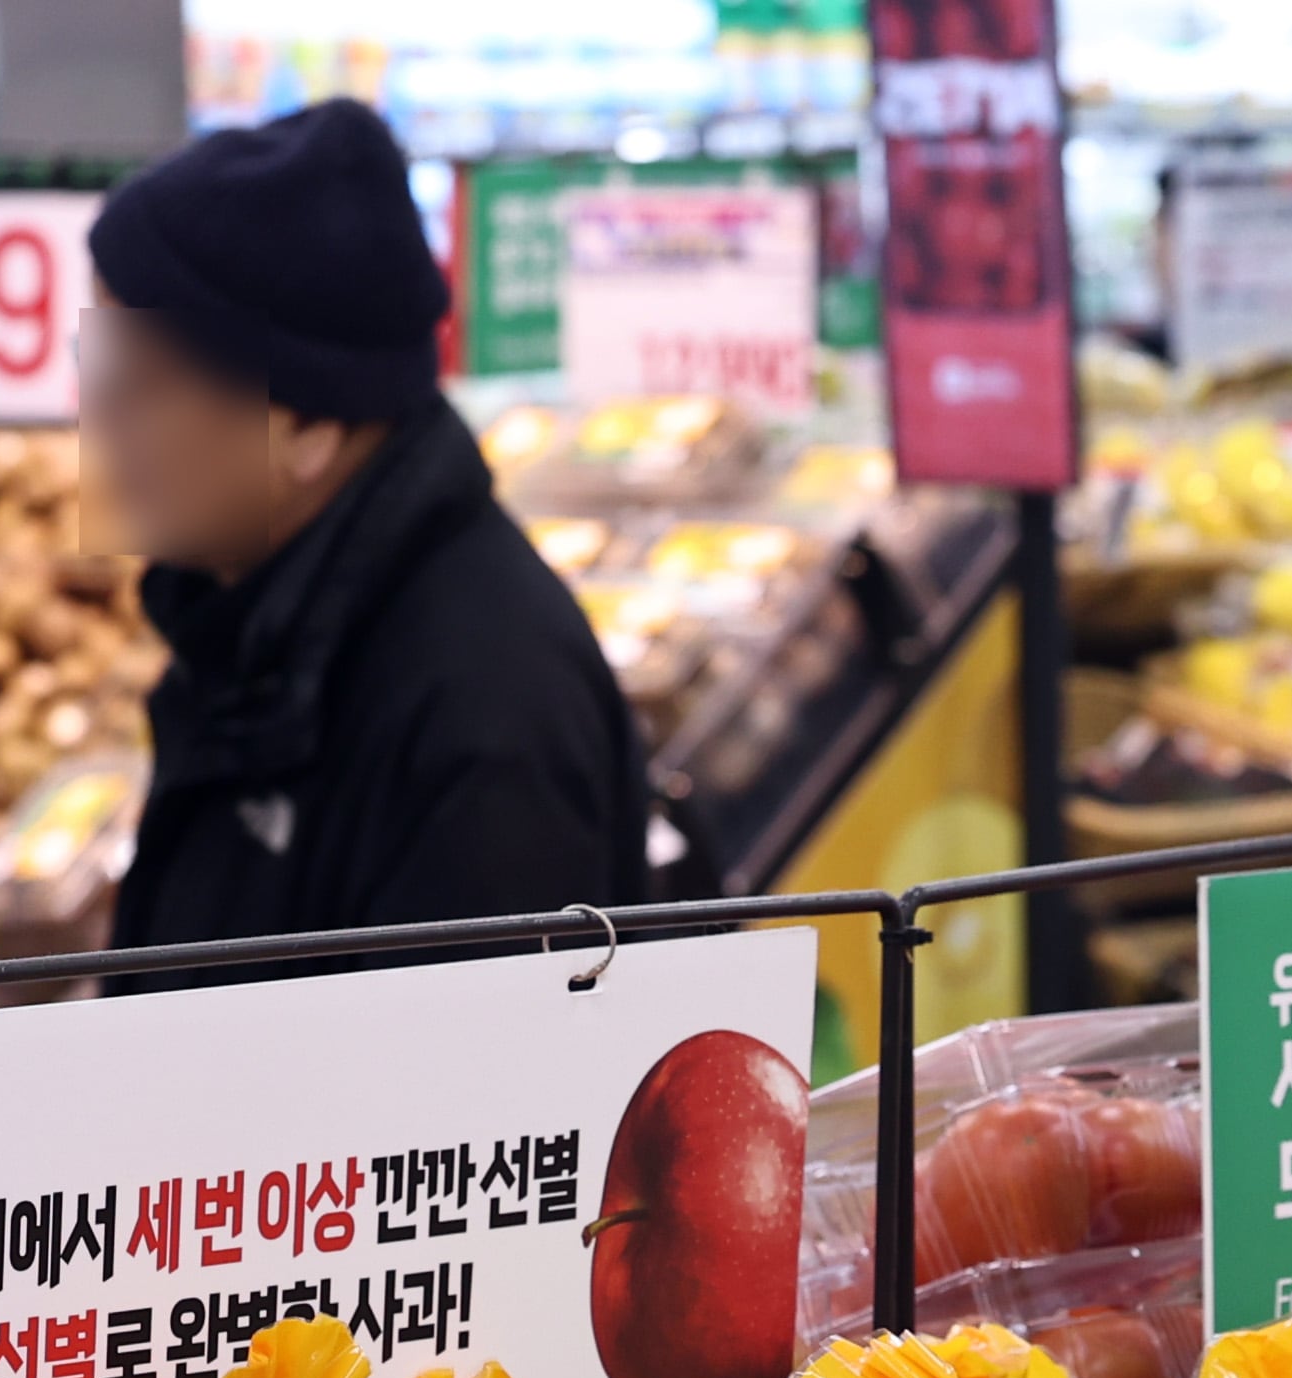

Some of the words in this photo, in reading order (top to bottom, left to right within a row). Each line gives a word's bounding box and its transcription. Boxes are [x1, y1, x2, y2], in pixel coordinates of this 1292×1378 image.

[127, 1177, 182, 1273] 세
[195, 1170, 244, 1268] 번
[257, 1156, 365, 1258] 이상
[371, 1143, 476, 1244] 깐깐
[480, 1129, 579, 1231] 선별
[349, 1261, 473, 1364] 사과!
